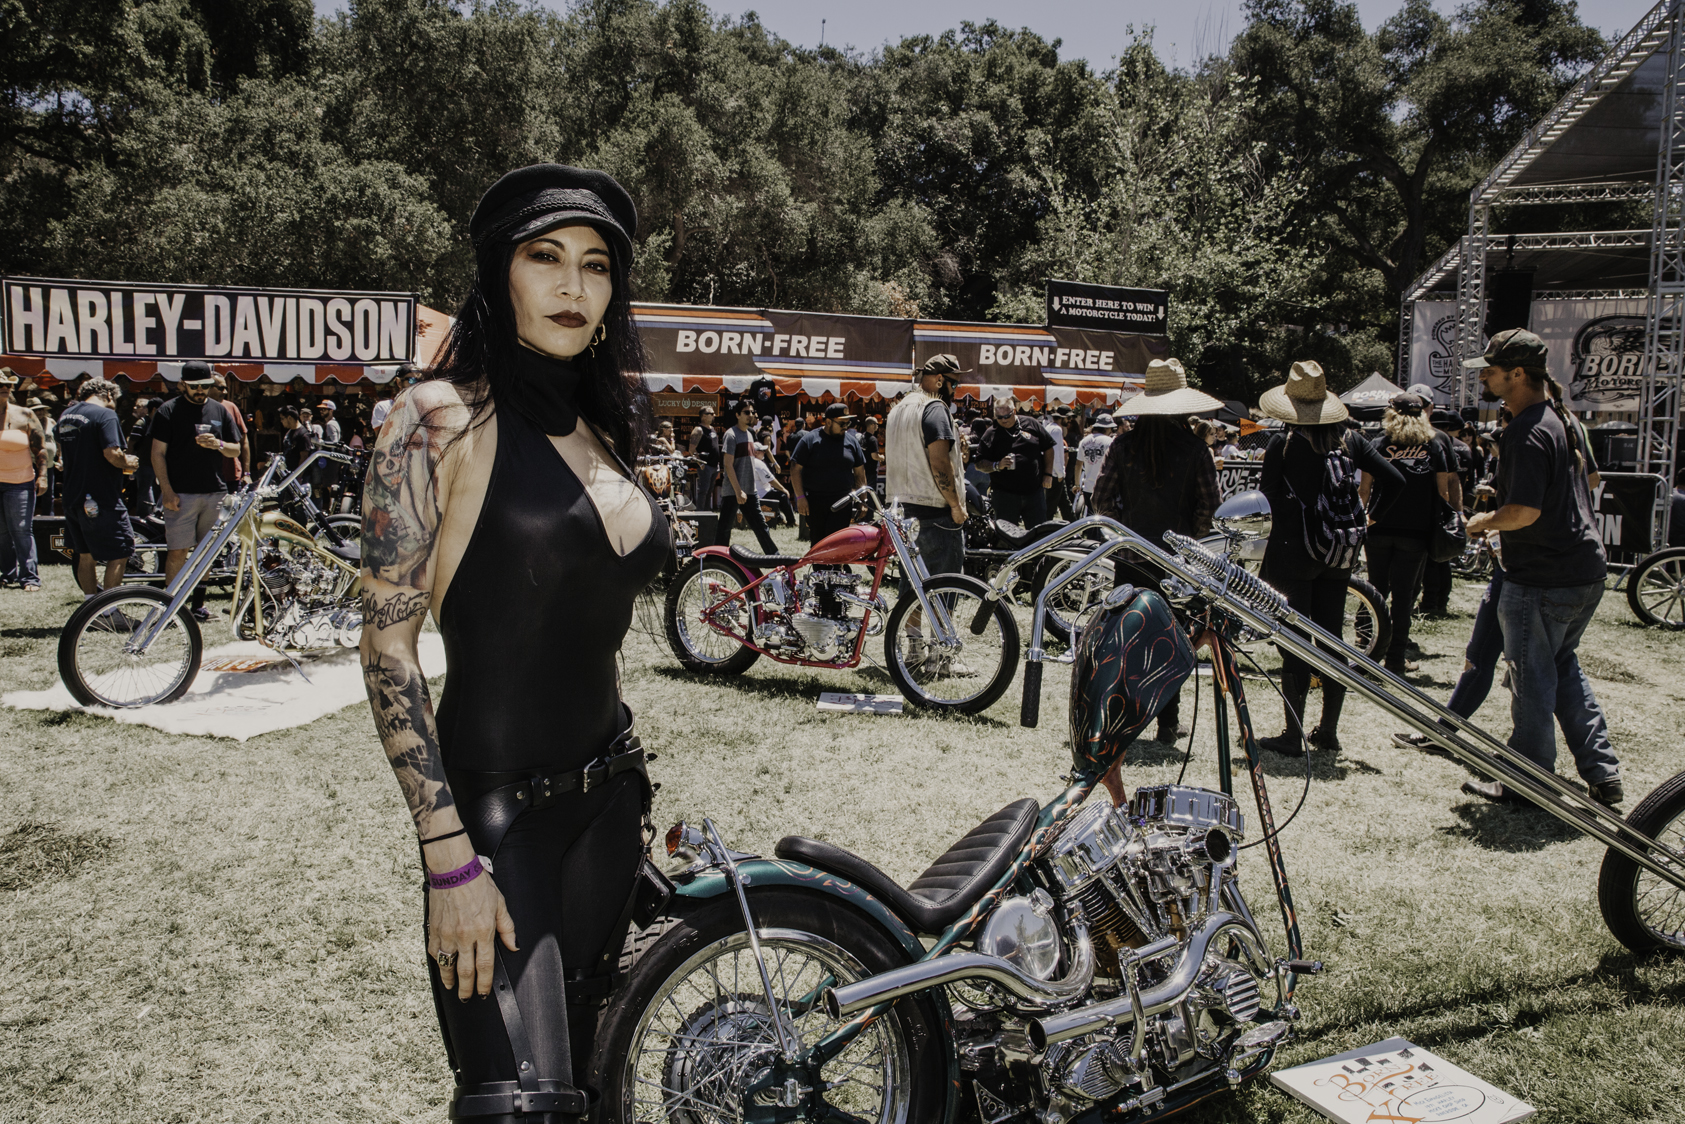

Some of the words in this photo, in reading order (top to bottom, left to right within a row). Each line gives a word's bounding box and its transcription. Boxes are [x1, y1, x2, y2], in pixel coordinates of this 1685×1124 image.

[1061, 296, 1094, 307] ENTER
[1095, 299, 1120, 309] HERE
[1121, 301, 1134, 310] TO
[1135, 303, 1155, 312] WIN
[10, 285, 408, 361] HARLEY-DAVIDSON
[1068, 308, 1125, 319] MOTORCYCLE
[1126, 313, 1156, 322] TODAY!
[676, 330, 846, 359] BORN-FREE
[979, 344, 1115, 371] BORN-FREE
[691, 400, 717, 408] DESIGN
[1383, 444, 1428, 462] Settle
[431, 869, 471, 887] SUNDAY
[1313, 1064, 1402, 1108] BORN
